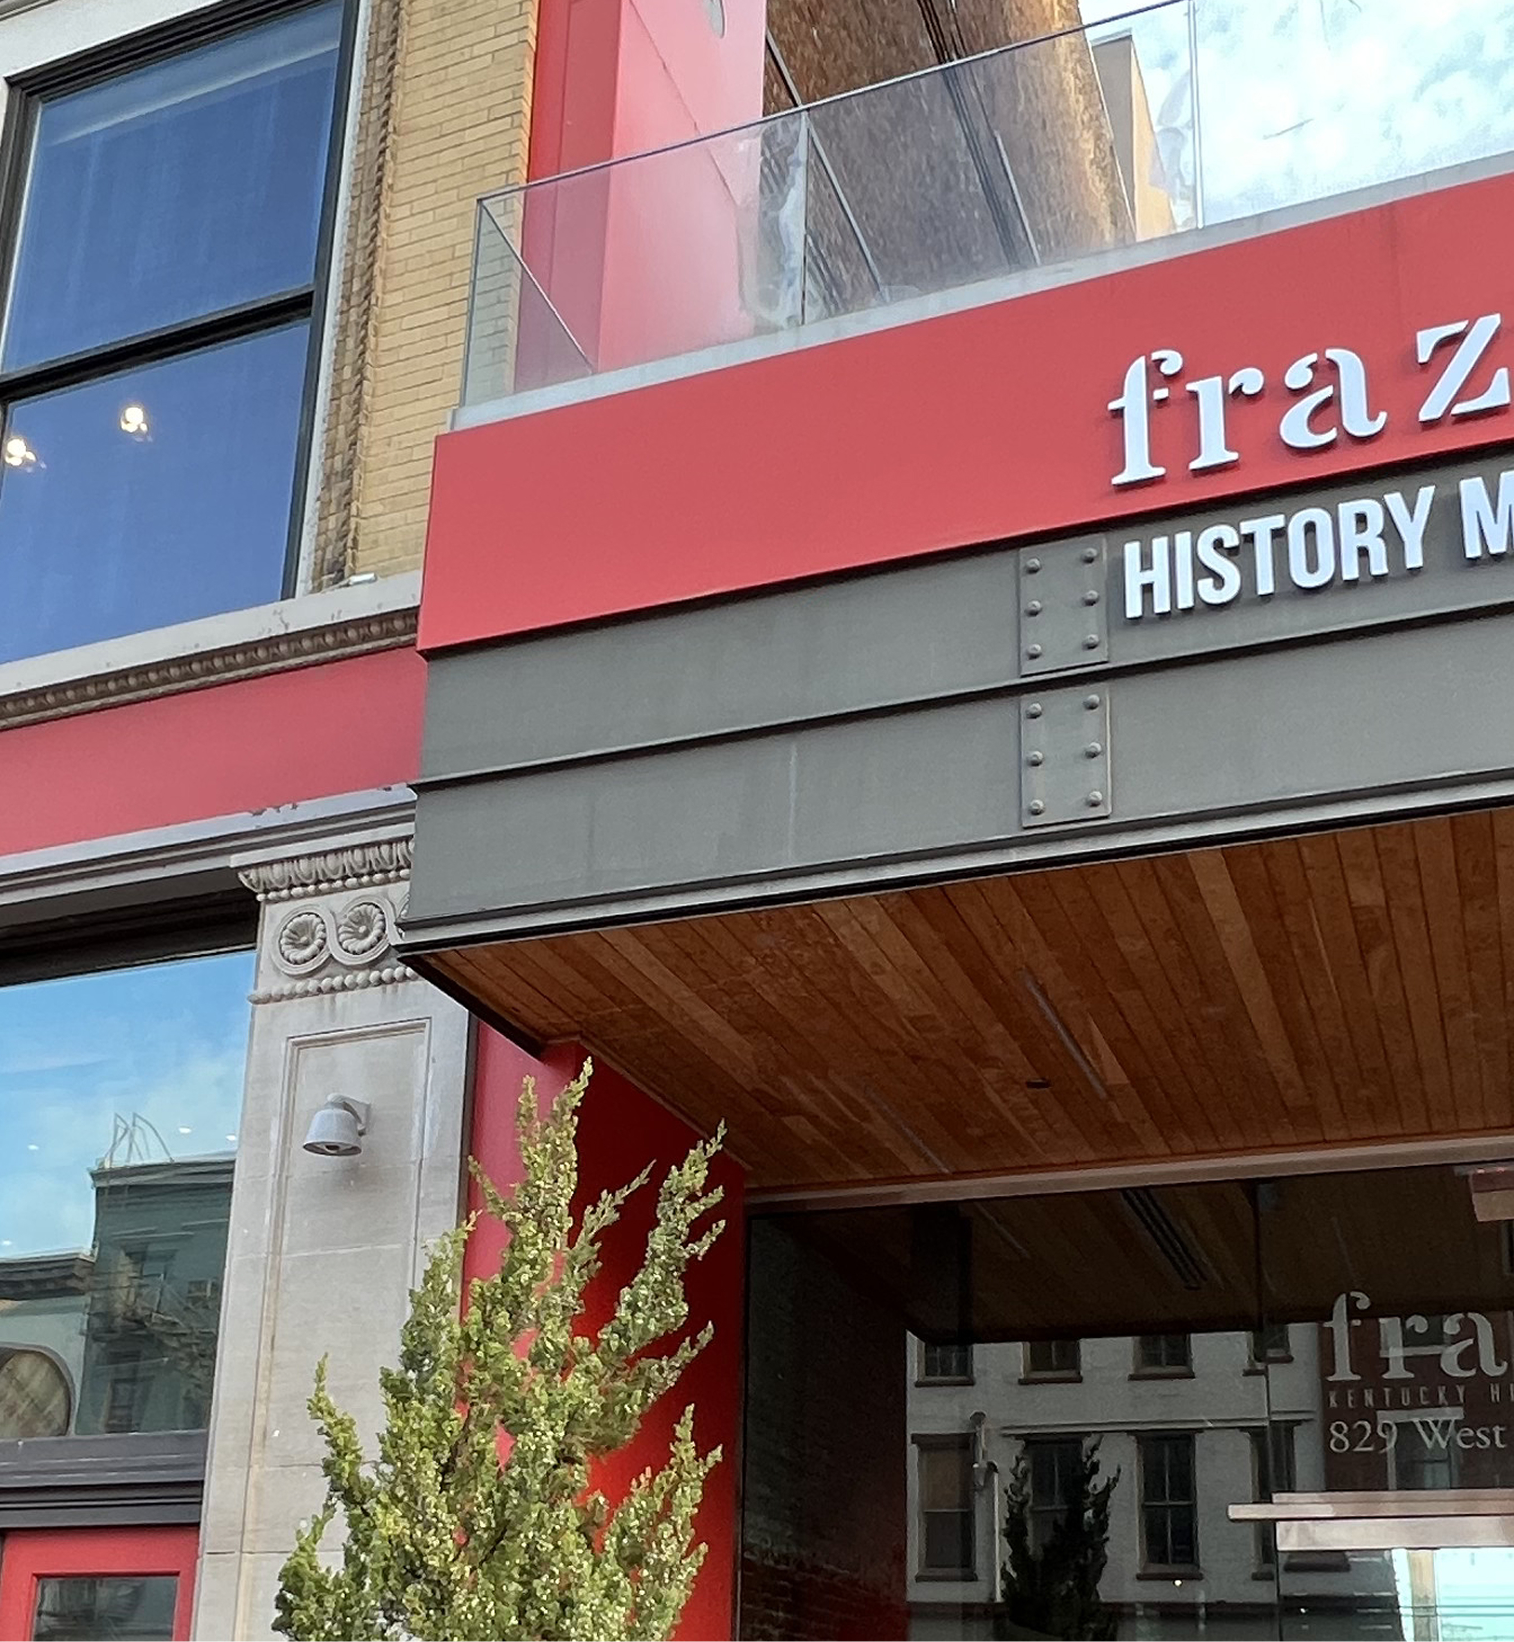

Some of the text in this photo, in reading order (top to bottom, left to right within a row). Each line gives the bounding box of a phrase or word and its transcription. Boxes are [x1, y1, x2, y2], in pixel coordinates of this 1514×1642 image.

[1123, 485, 1436, 620] HISTORY
[1329, 1383, 1466, 1409] KENTUCKY
[1328, 1420, 1398, 1455] 829
[1410, 1417, 1508, 1450] West
